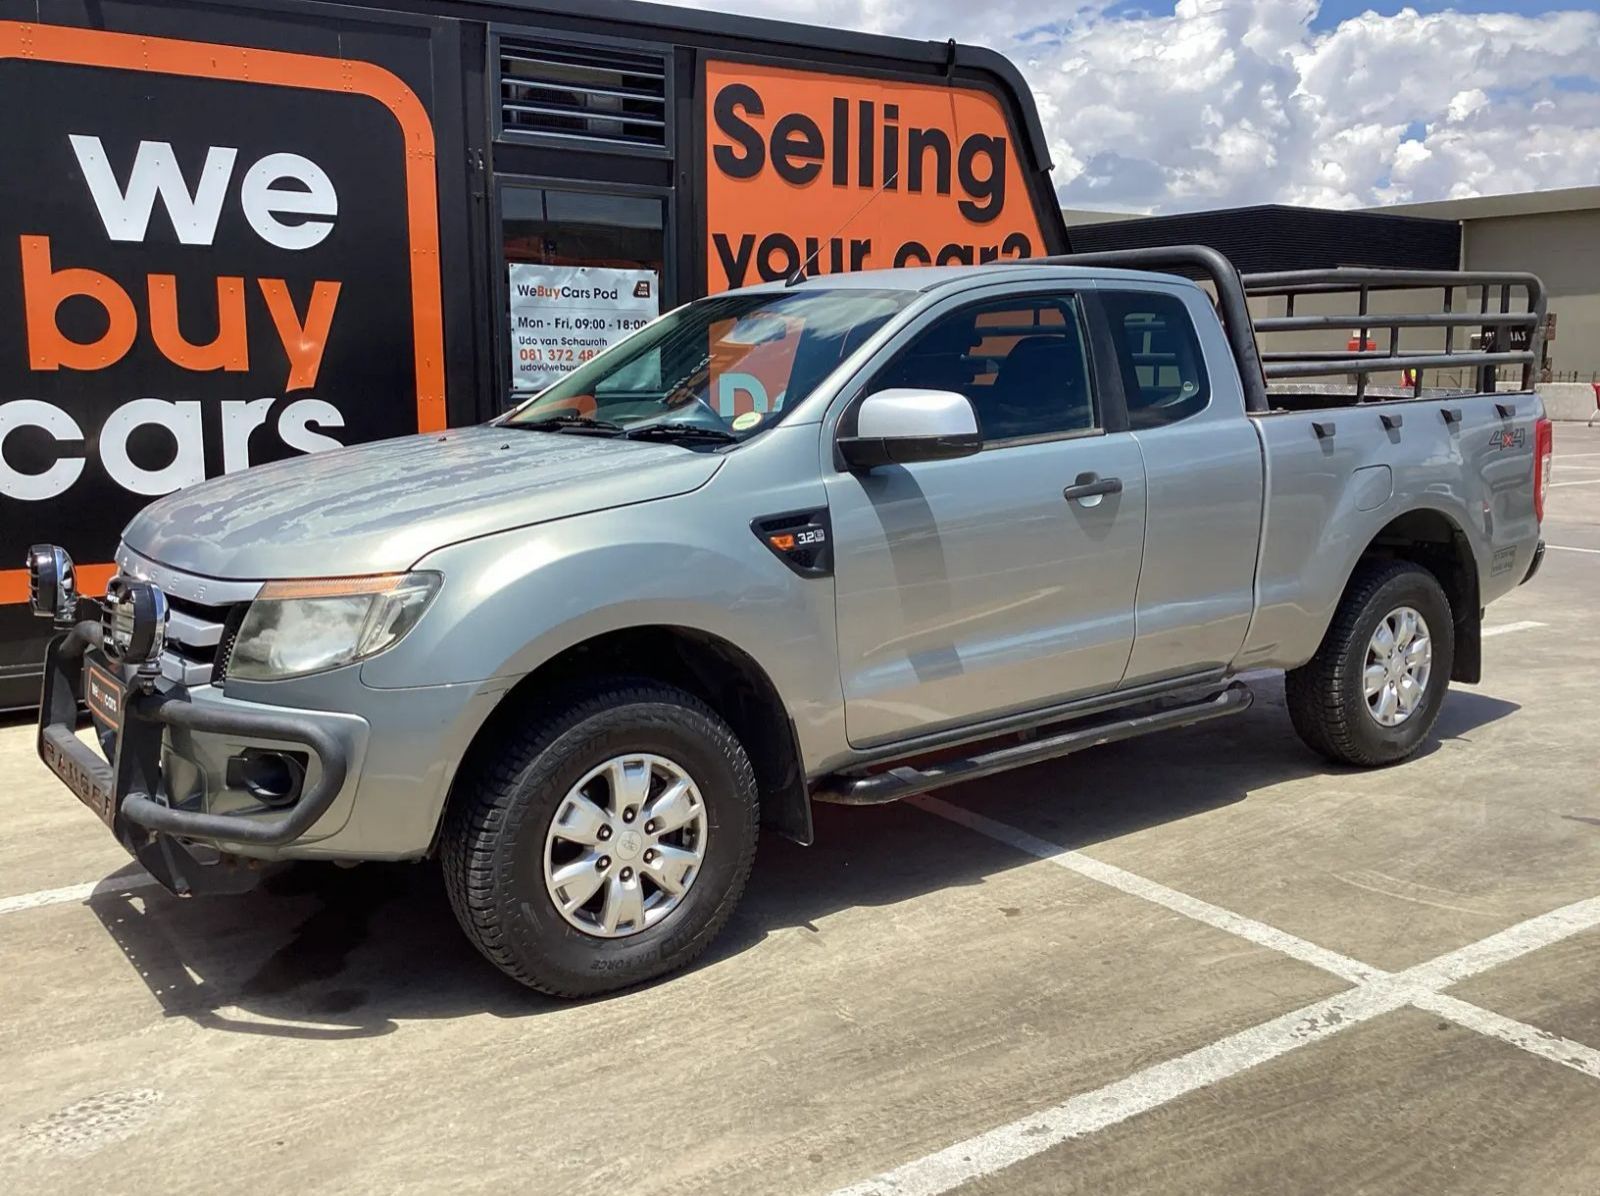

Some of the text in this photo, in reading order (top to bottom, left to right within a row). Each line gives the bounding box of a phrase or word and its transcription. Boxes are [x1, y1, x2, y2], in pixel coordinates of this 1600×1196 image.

[713, 83, 1006, 223] Selling
[69, 134, 338, 250] we
[712, 232, 872, 290] your
[20, 235, 342, 393] buy
[517, 284, 591, 300] WeBuyCars
[593, 287, 618, 300] Pod
[518, 317, 544, 329] Mon
[554, 318, 573, 330] Fri,
[575, 318, 606, 329] 09:00
[518, 336, 608, 346] Udo van Schauroth
[519, 349, 543, 361] 081
[548, 350, 574, 362] 372
[0, 397, 346, 500] cars
